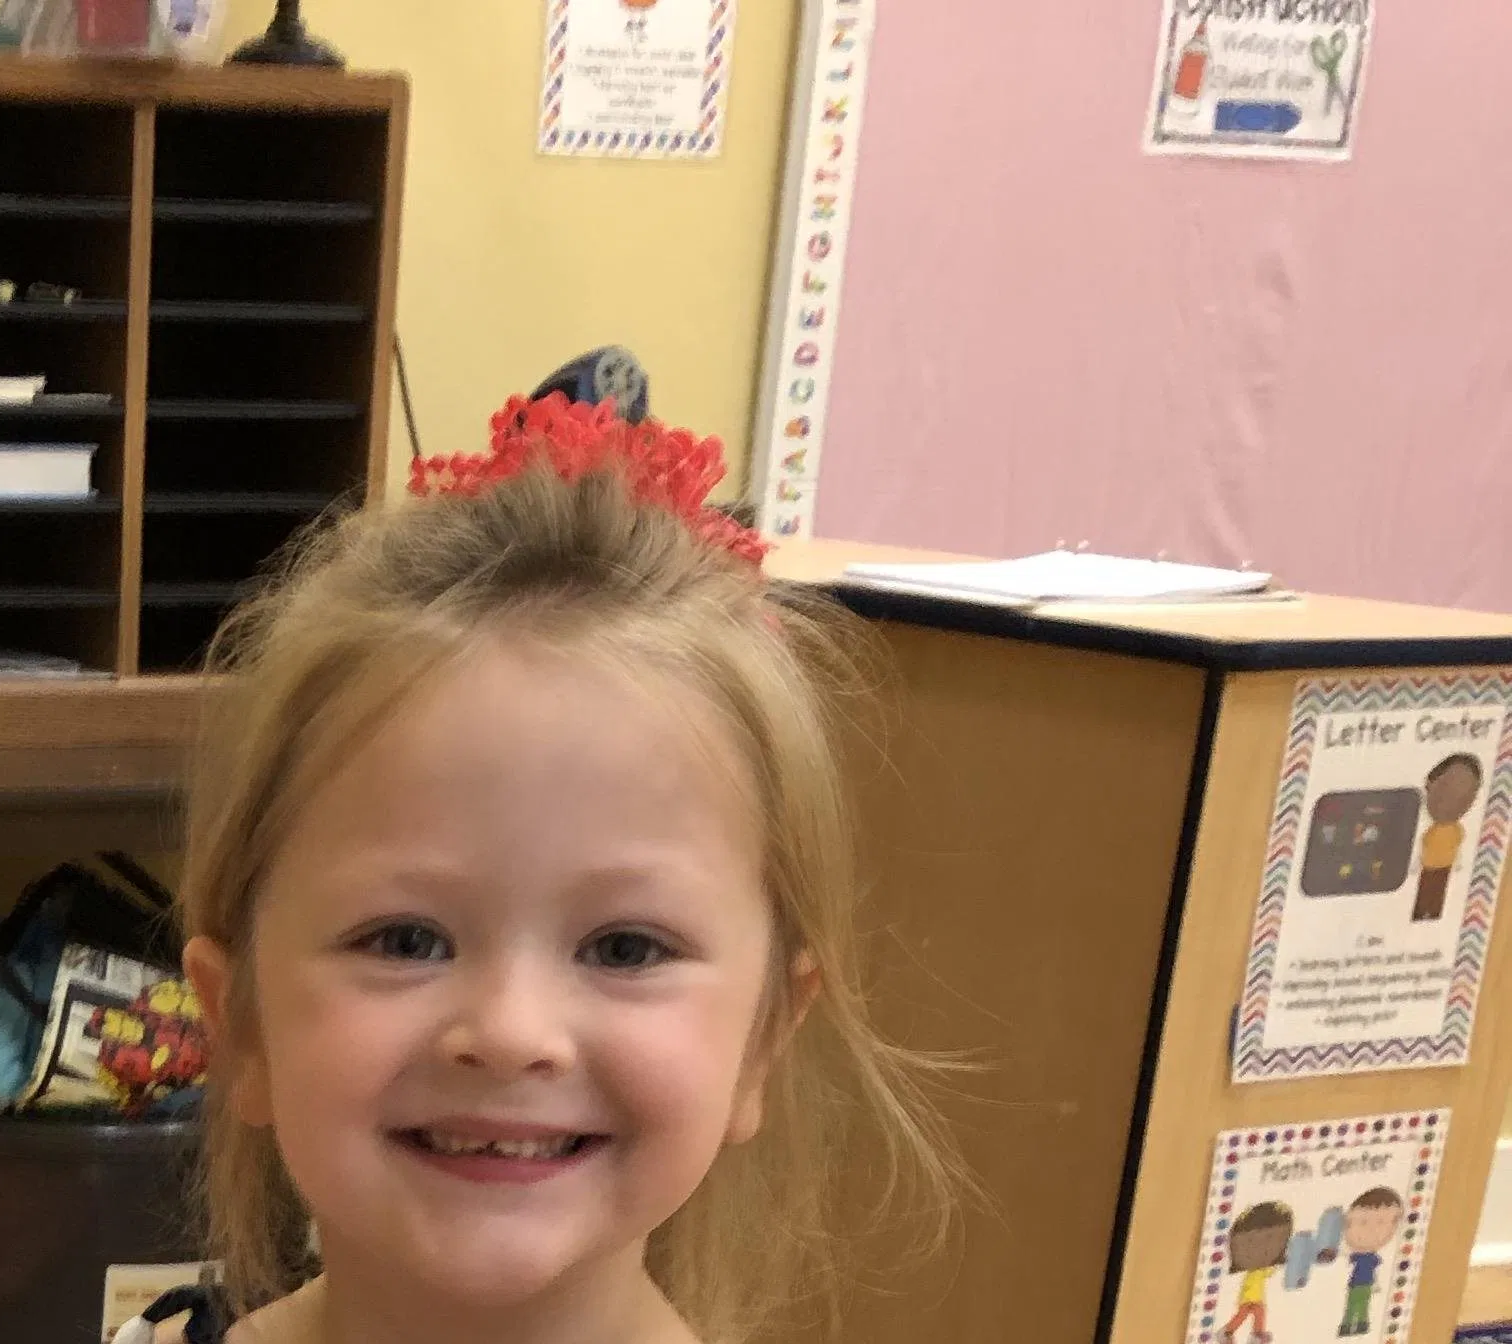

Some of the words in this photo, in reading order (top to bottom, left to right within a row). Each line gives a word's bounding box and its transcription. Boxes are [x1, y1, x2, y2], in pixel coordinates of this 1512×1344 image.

[1324, 717, 1405, 749] Letter
[1416, 713, 1497, 743] Center
[1260, 1156, 1314, 1184] Math
[1321, 1151, 1393, 1178] Center
